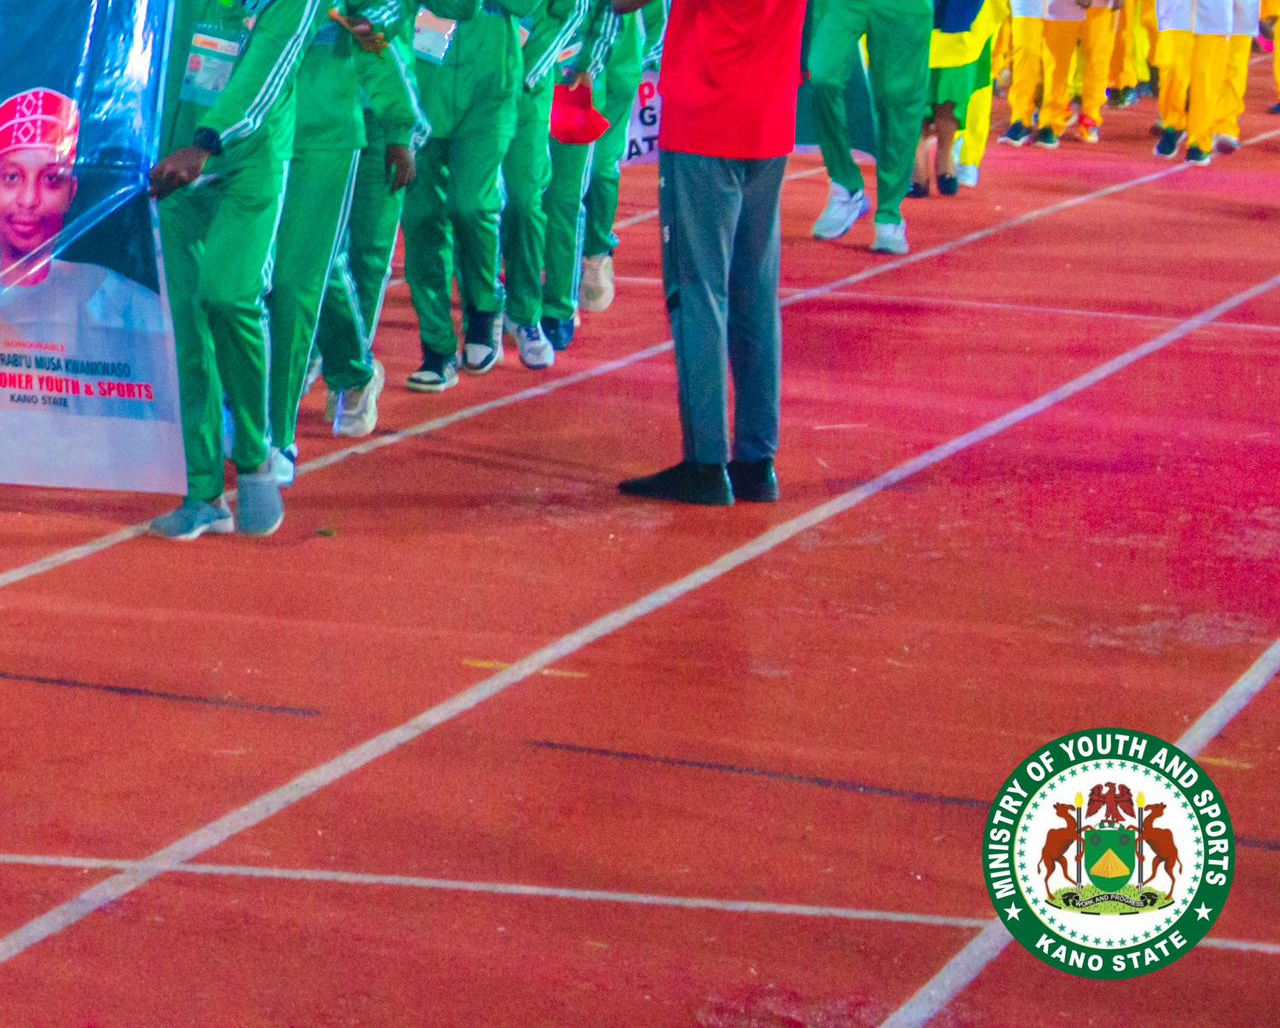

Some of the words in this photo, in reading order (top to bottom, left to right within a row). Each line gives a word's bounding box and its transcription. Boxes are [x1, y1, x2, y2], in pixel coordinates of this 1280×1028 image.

[34, 356, 62, 371] MUSA
[38, 374, 80, 394] YOUTH
[84, 383, 95, 396] &
[98, 381, 154, 401] SPORTS
[10, 393, 38, 405] KANO
[42, 396, 69, 408] STATE
